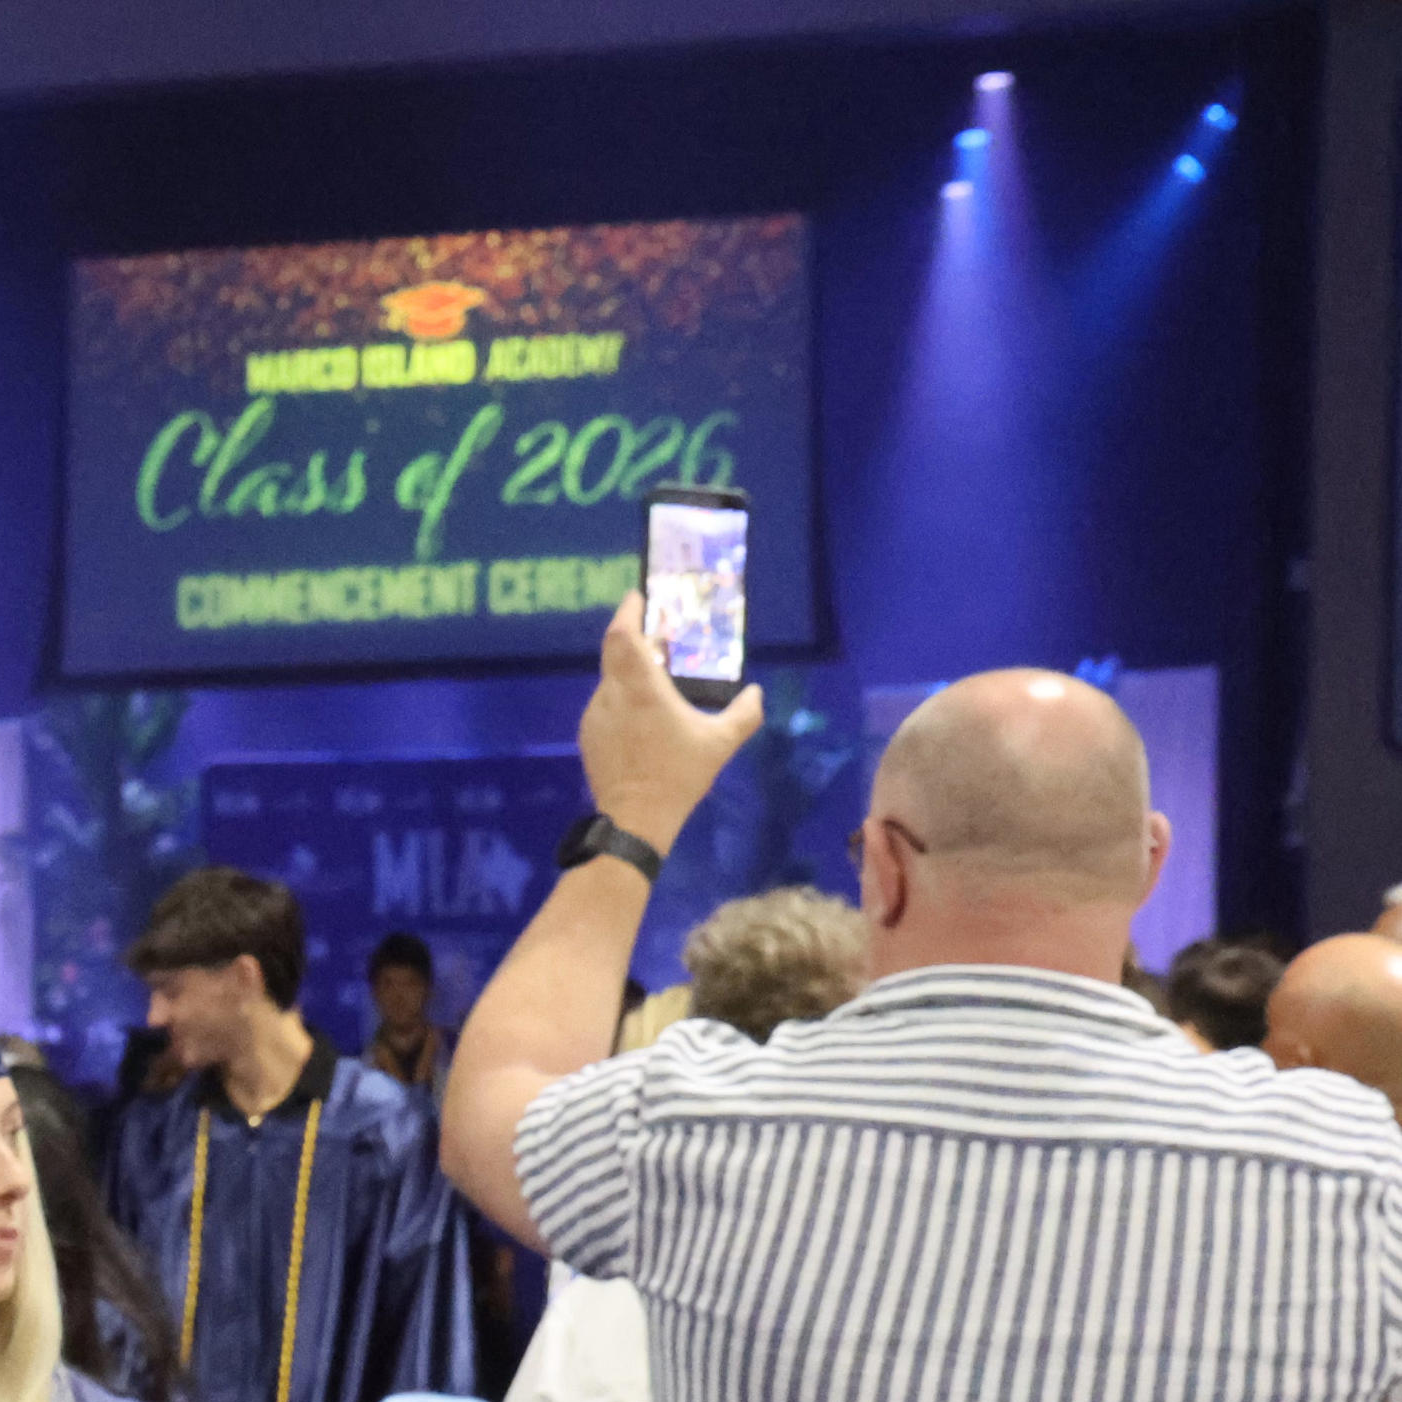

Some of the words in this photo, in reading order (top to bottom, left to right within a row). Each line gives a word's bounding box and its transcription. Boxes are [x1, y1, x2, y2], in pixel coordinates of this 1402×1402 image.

[361, 339, 476, 387] ISLAND
[481, 331, 626, 382] ACADEMY
[135, 398, 367, 532] Class
[395, 401, 504, 559] of
[502, 411, 737, 505] 2026
[176, 561, 480, 629] COMMENCEMENT
